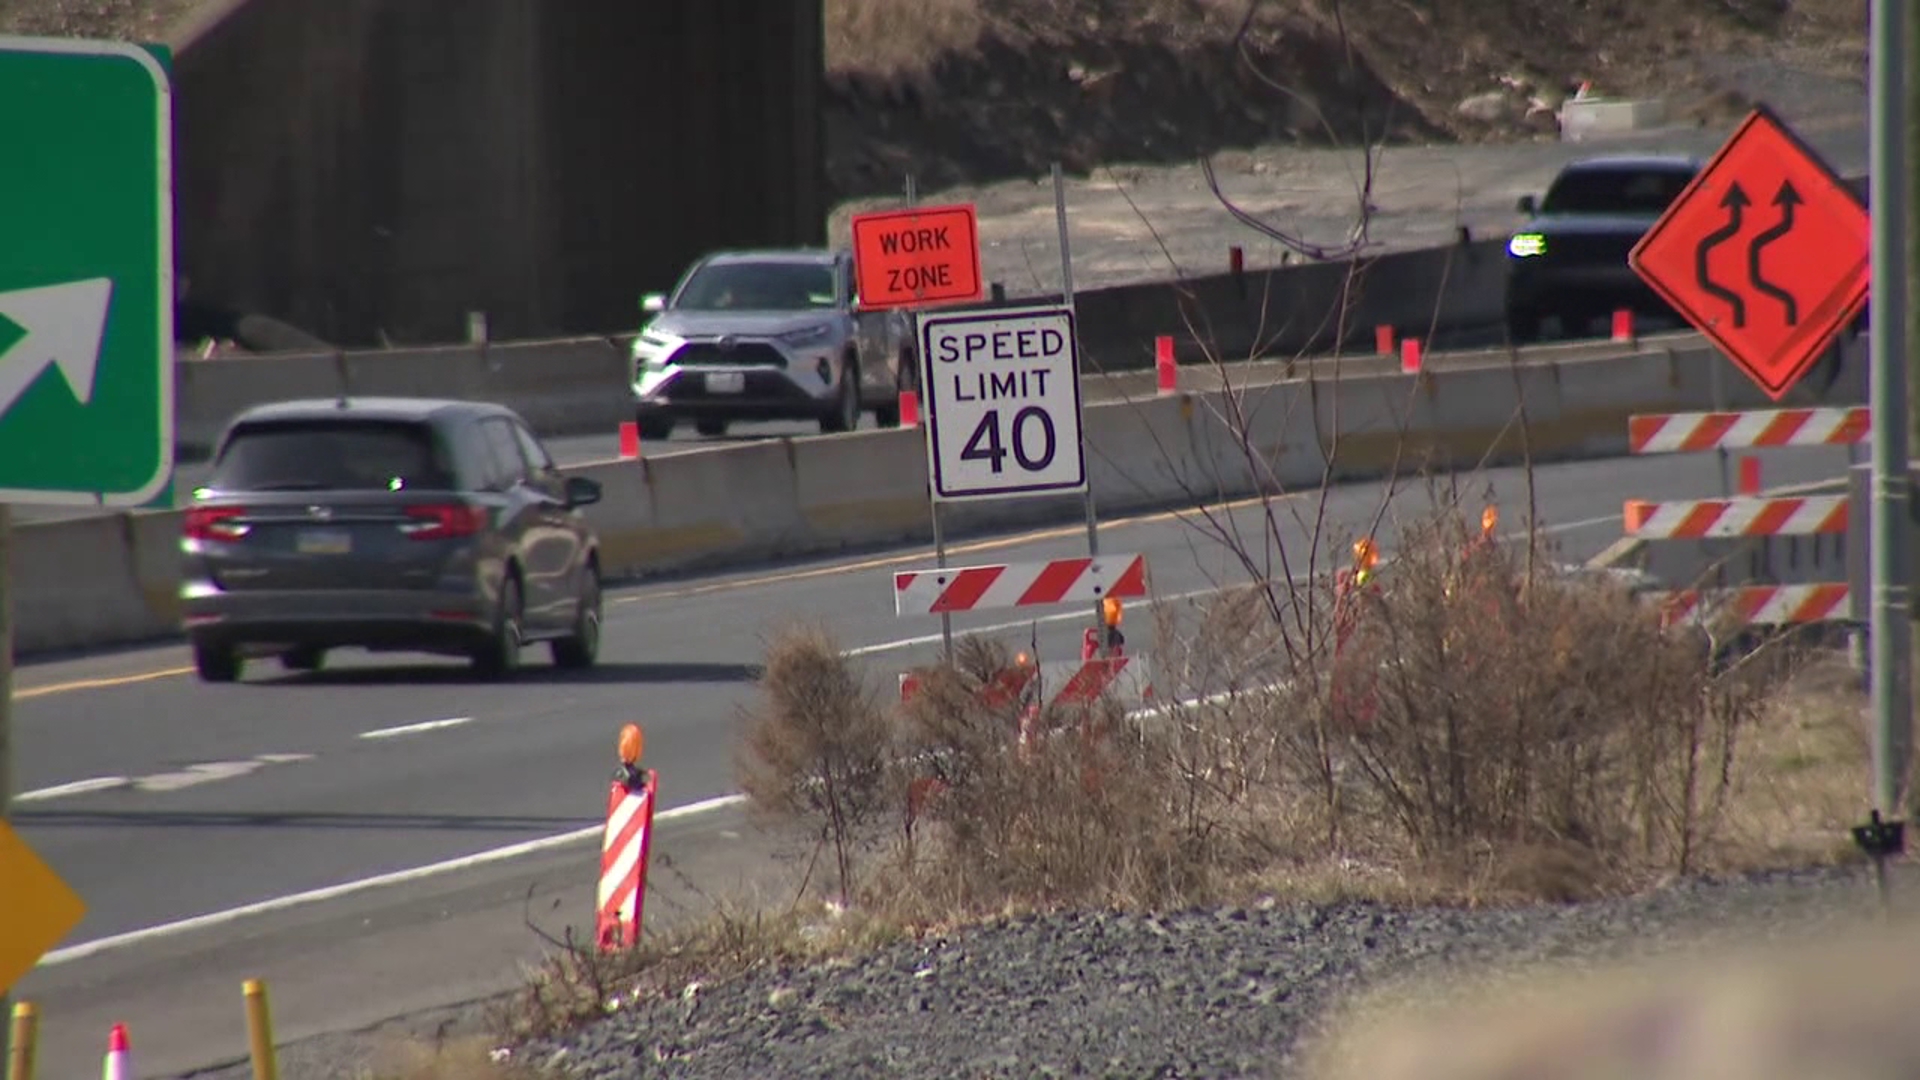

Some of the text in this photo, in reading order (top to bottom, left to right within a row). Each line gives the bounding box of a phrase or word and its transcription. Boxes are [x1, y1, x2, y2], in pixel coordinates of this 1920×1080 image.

[880, 227, 950, 255] WORK
[887, 264, 952, 292] ZONE
[939, 329, 1063, 363] SPEED
[954, 369, 1051, 401] LIMIT
[960, 406, 1056, 474] 40
